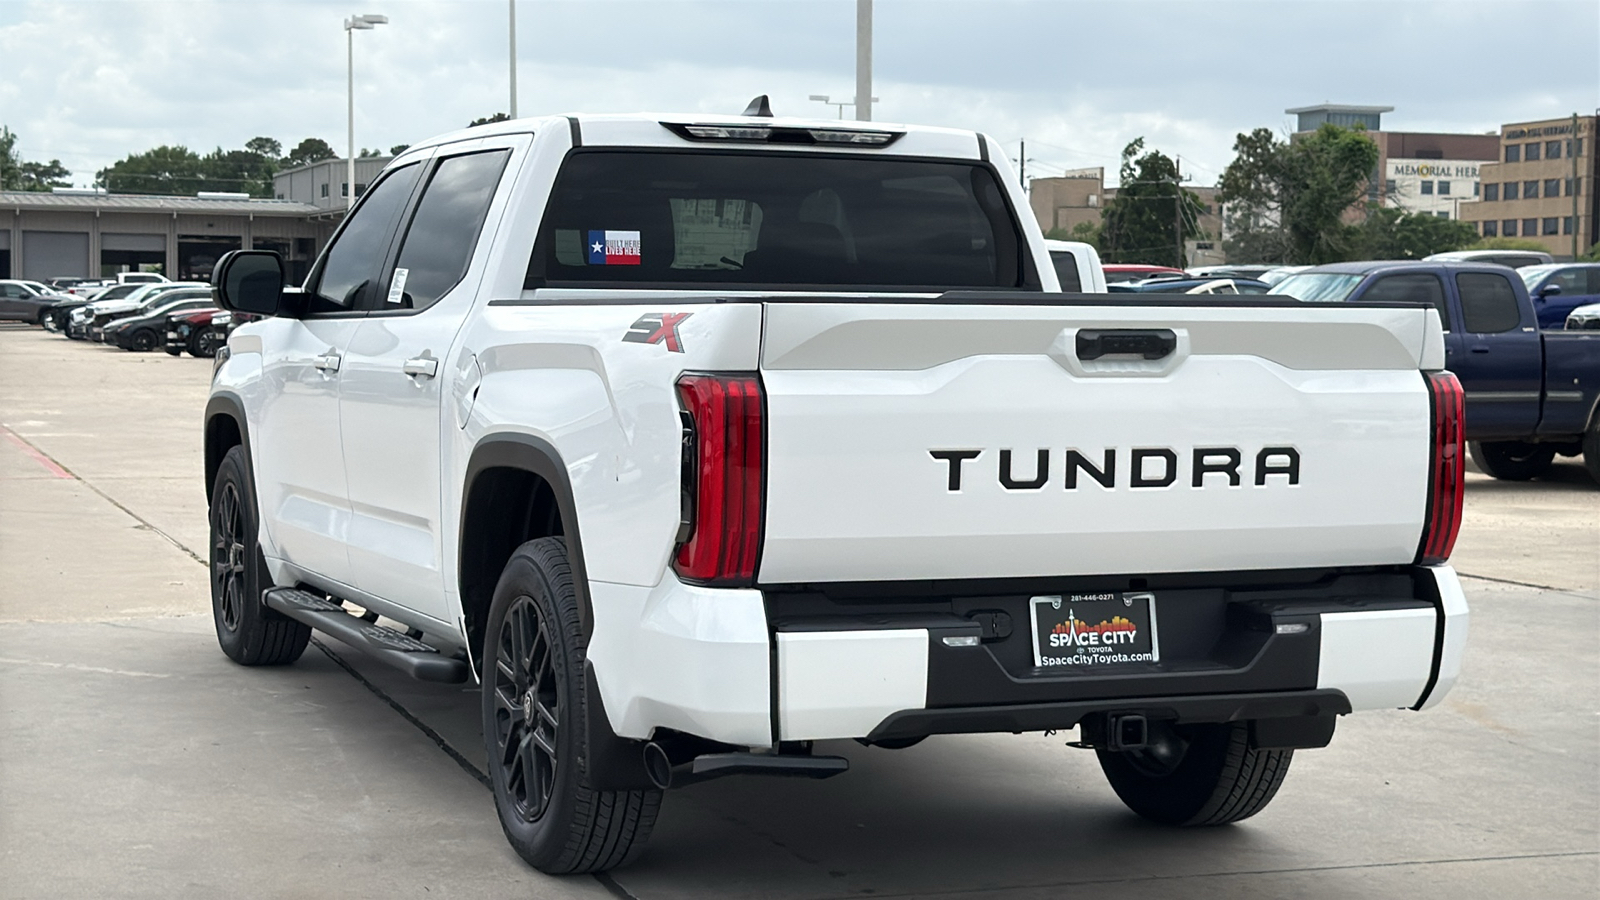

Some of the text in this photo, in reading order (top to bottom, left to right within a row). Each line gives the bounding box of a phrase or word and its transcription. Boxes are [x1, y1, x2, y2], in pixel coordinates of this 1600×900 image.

[1394, 165, 1452, 177] MEMORIAL
[606, 240, 641, 248] BUILT HERE
[606, 247, 641, 256] LIVES HERE
[929, 446, 1301, 492] TUNDRA
[1049, 630, 1137, 647] SPACE CITY
[1087, 646, 1113, 654] TOYOTA
[1042, 652, 1152, 667] SpaceCityToyota.com
